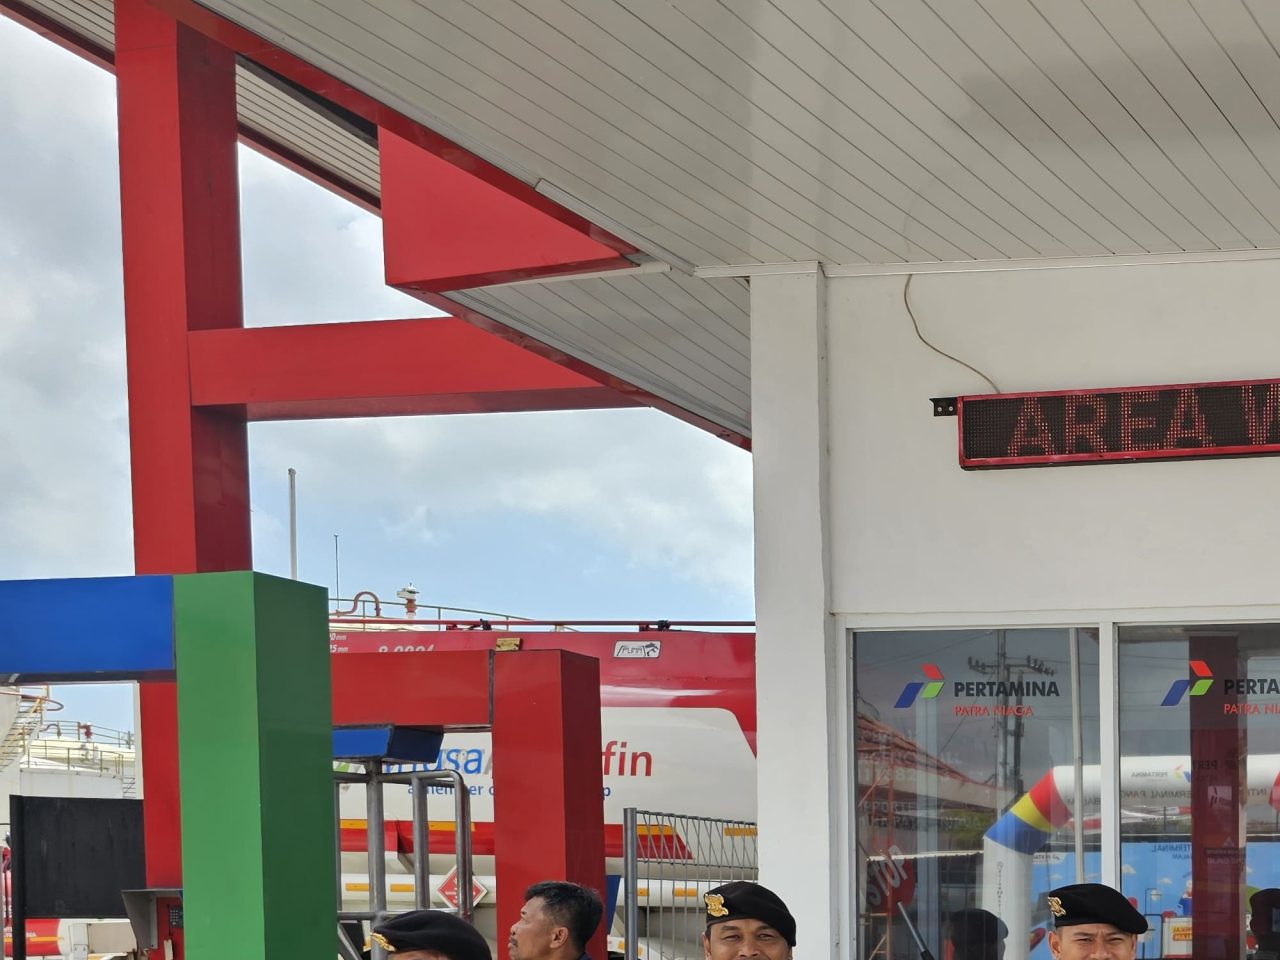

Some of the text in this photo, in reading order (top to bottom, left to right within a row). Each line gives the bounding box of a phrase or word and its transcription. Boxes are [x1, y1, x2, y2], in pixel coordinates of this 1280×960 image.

[1007, 388, 1215, 457] AREA
[954, 681, 1060, 697] PERTAMINA
[954, 705, 1034, 717] PATRA NIAGA
[1223, 704, 1260, 715] PATRA
